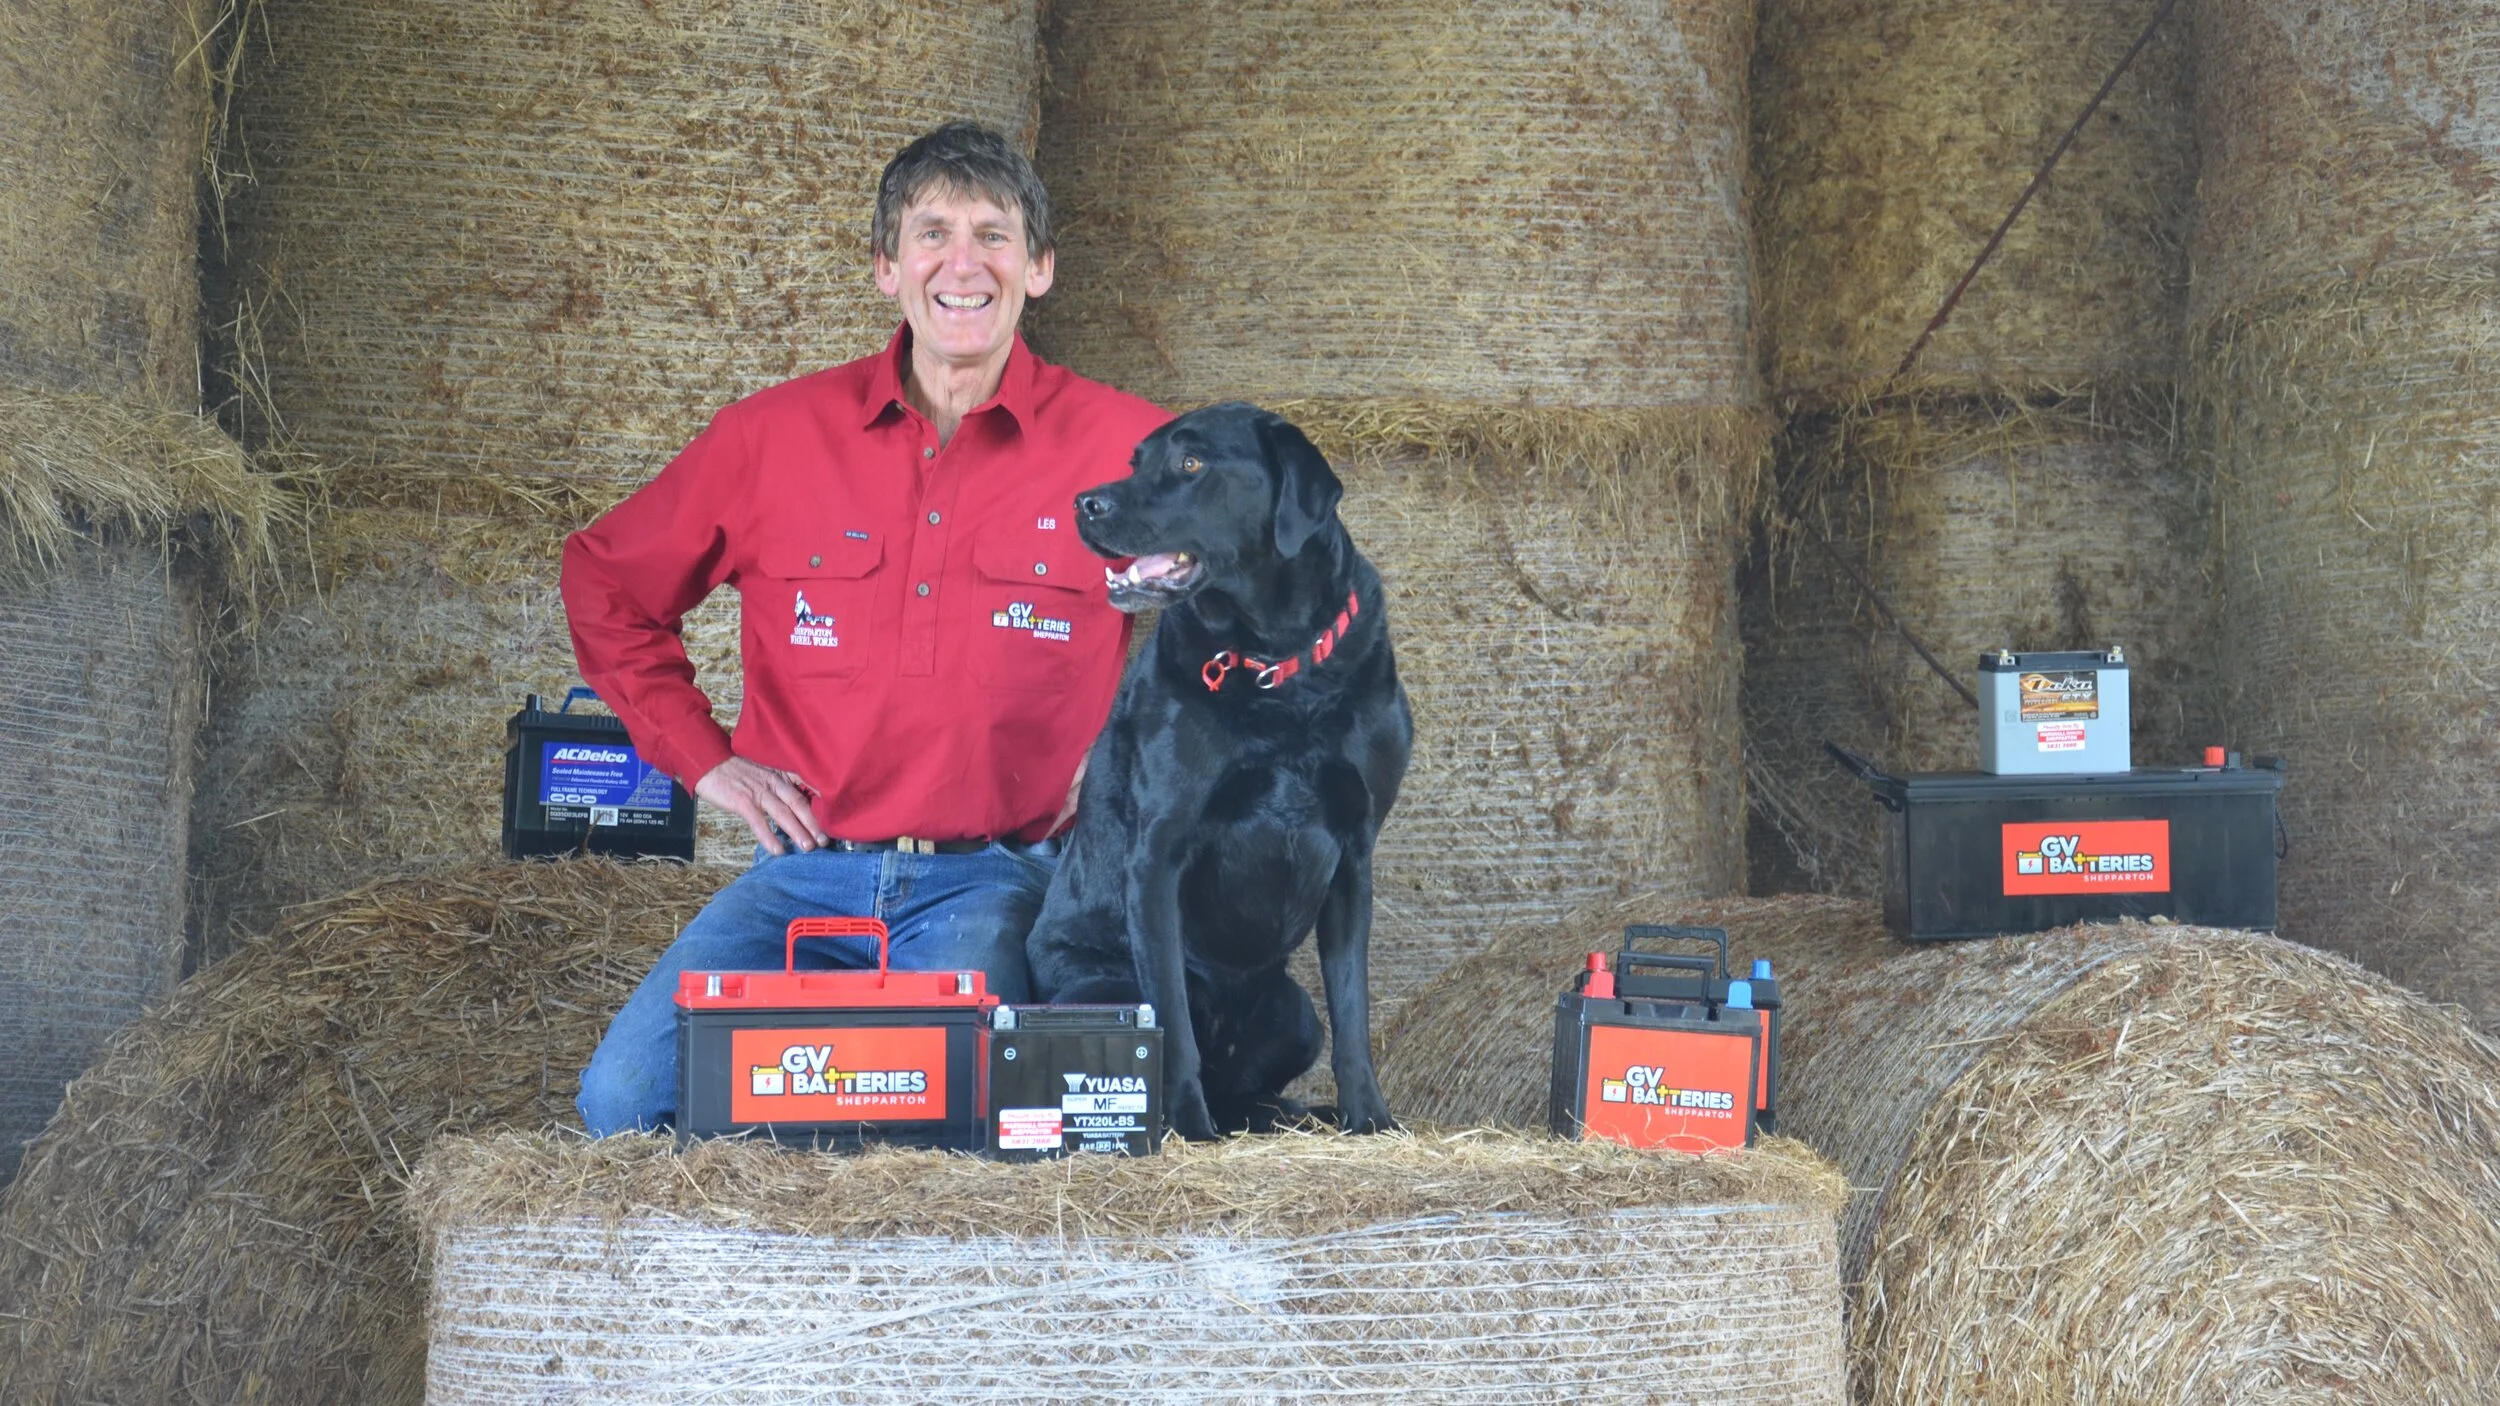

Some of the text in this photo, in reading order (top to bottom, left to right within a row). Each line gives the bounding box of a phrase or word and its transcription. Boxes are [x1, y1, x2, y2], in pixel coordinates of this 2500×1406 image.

[1037, 518, 1056, 529] LES
[1008, 602, 1033, 618] GV
[1012, 615, 1071, 633] BATTERIES
[812, 637, 839, 648] WORKS
[553, 747, 628, 763] ACDelco
[552, 767, 624, 778] Sealed Maintenance Free
[550, 785, 562, 793] FULL
[578, 787, 608, 795] TECHNOLOGY
[2041, 836, 2080, 857] GV
[2049, 853, 2154, 874] BATTERIES
[2083, 874, 2154, 882] SHEPPARTON
[781, 1045, 833, 1073] GV
[792, 1067, 928, 1094] BATTERIES
[1085, 1077, 1147, 1093] YUASA
[1626, 1066, 1665, 1088] GV
[836, 1096, 926, 1106] SHEPPARTON
[1094, 1097, 1118, 1111] MF
[1633, 1085, 1734, 1110] BATTERIES
[1073, 1115, 1135, 1127] YTX20L-BS
[1664, 1107, 1733, 1119] SHEPPARTON
